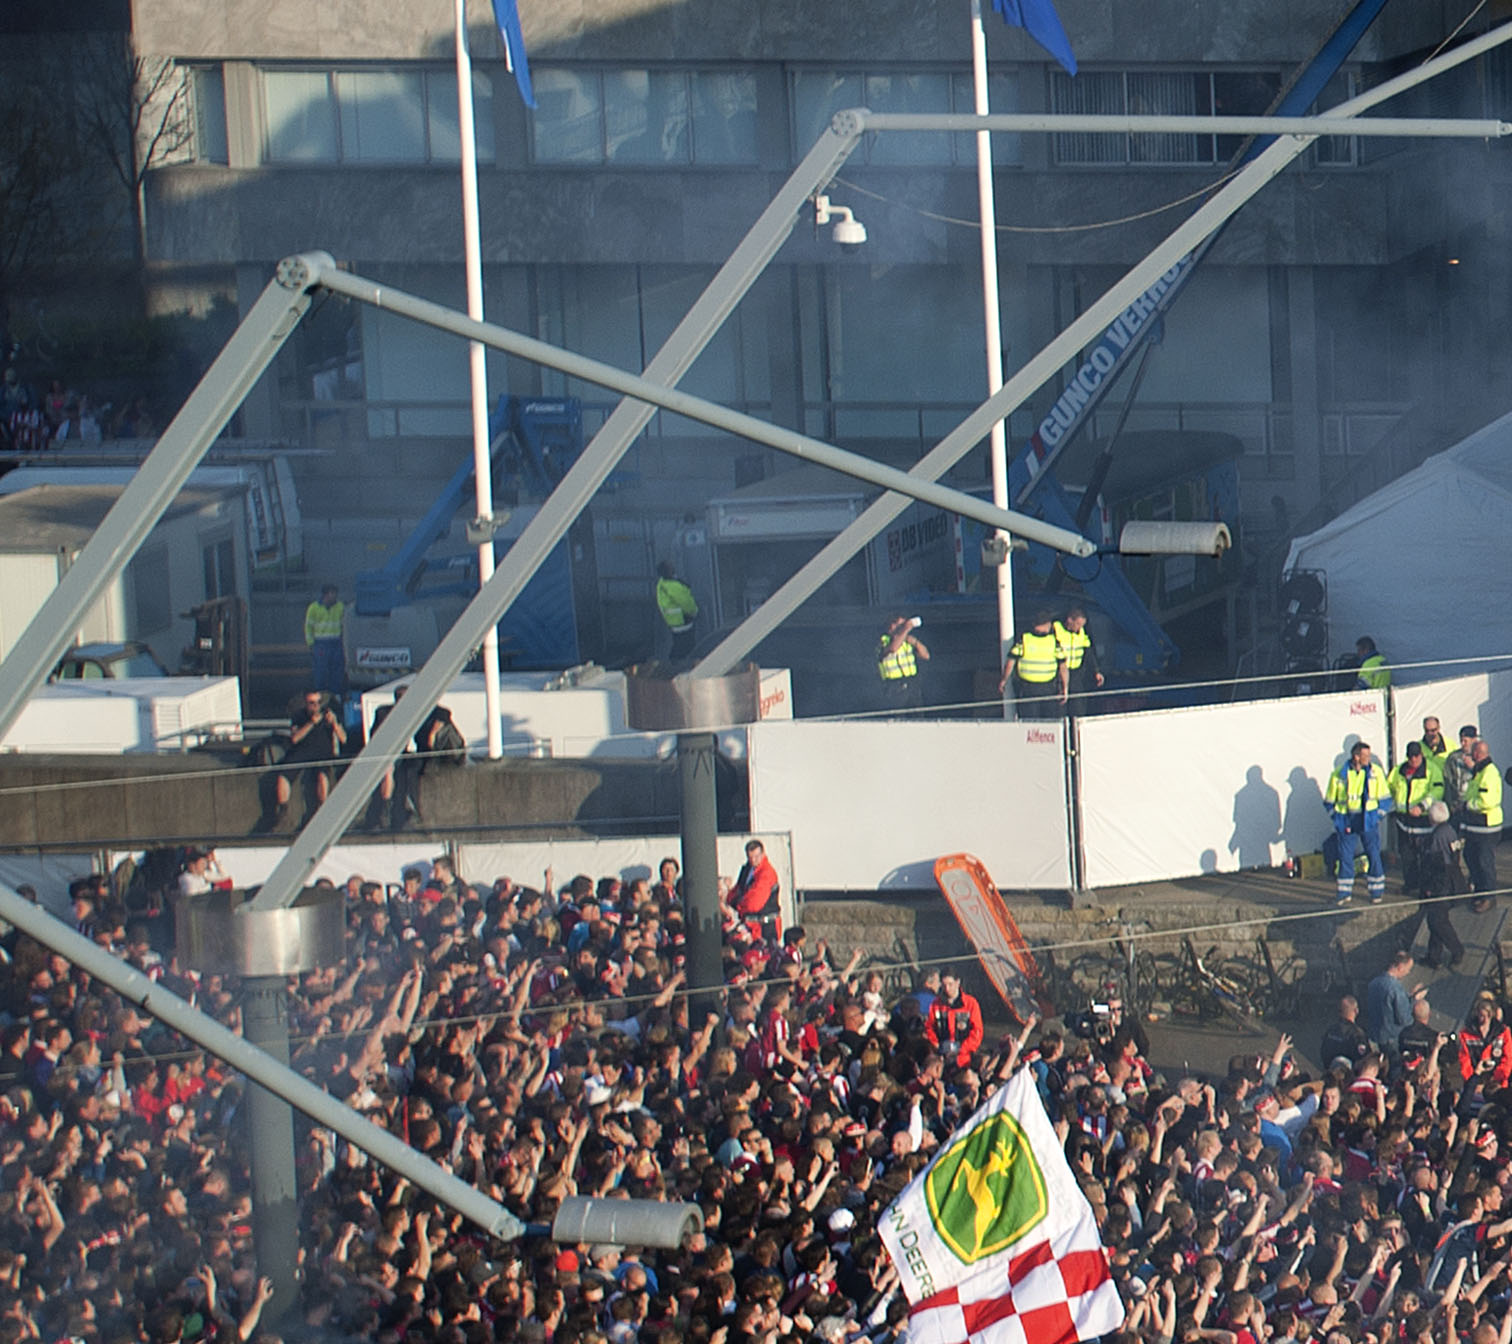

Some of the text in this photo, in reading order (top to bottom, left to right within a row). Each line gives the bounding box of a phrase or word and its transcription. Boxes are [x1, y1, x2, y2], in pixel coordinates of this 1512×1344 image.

[1037, 343, 1117, 447] GUNCO
[901, 511, 948, 553] DB VIDEO
